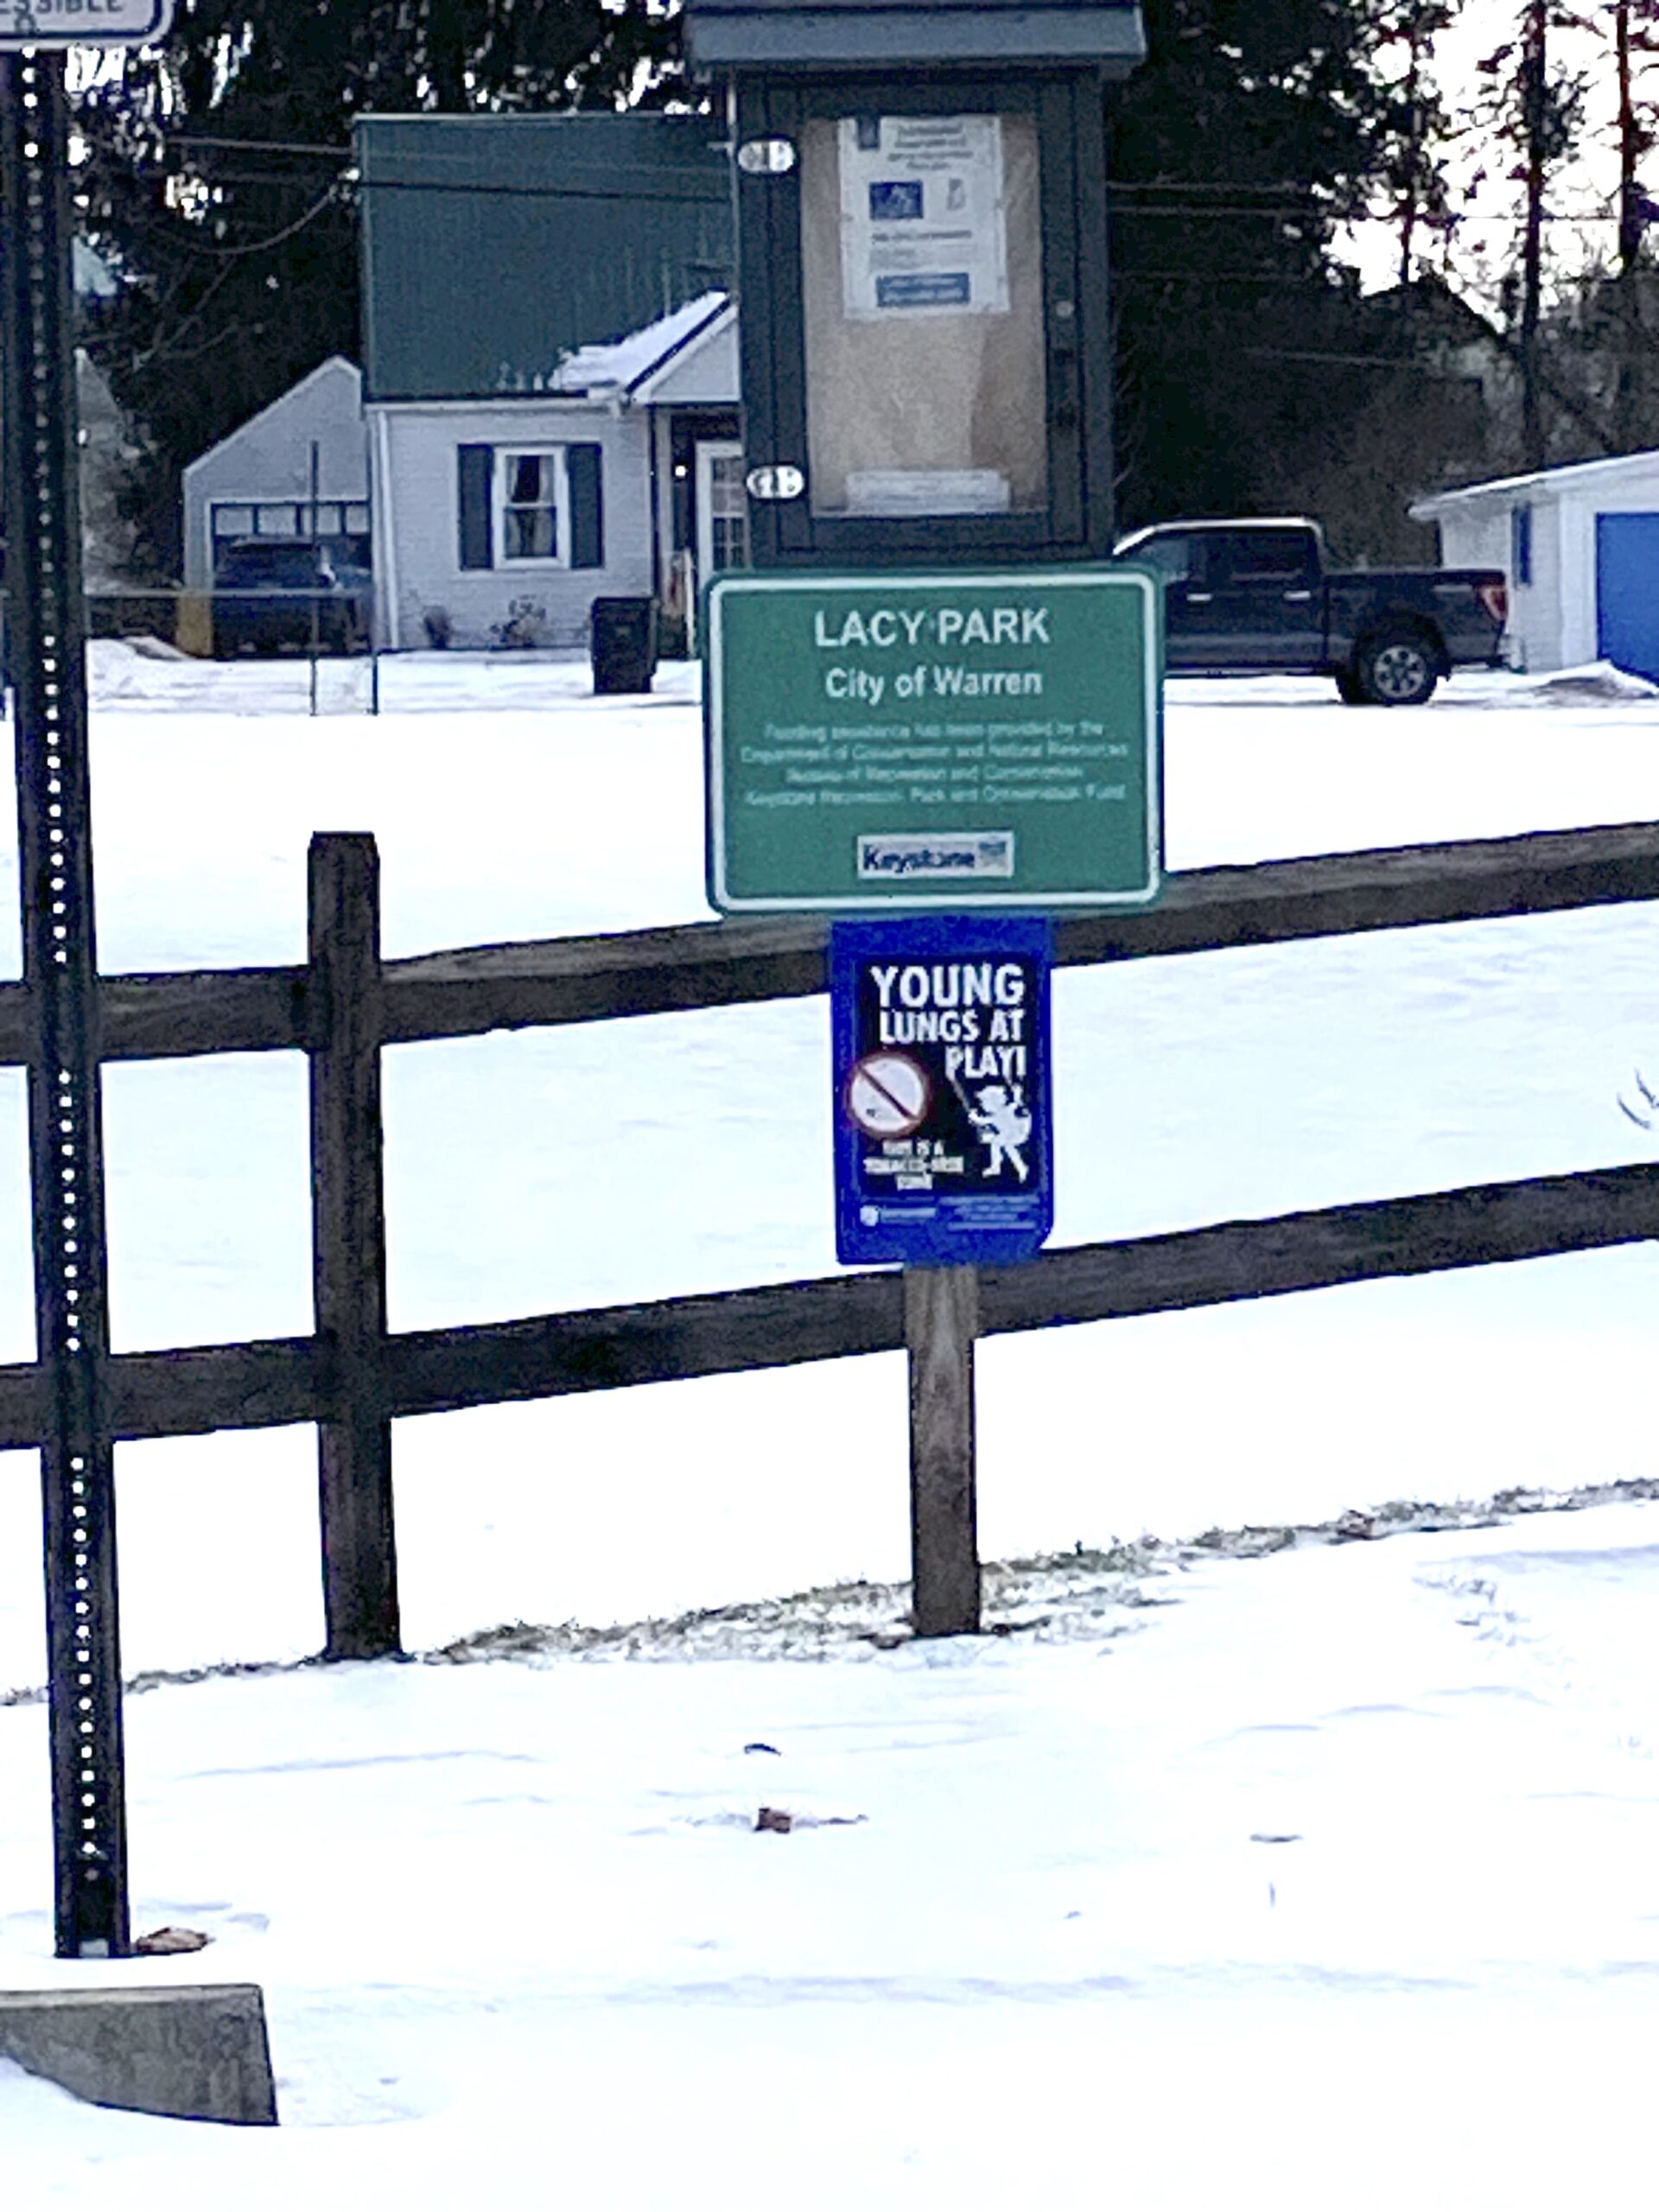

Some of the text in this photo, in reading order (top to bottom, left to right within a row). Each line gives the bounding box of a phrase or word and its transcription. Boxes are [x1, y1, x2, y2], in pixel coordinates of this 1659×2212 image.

[815, 607, 1050, 646] LACY PARK
[825, 664, 1043, 706] City of Warren
[863, 844, 976, 874] Keystone
[870, 963, 1026, 1008] YOUNG
[880, 1008, 1027, 1045] LUNGS AT
